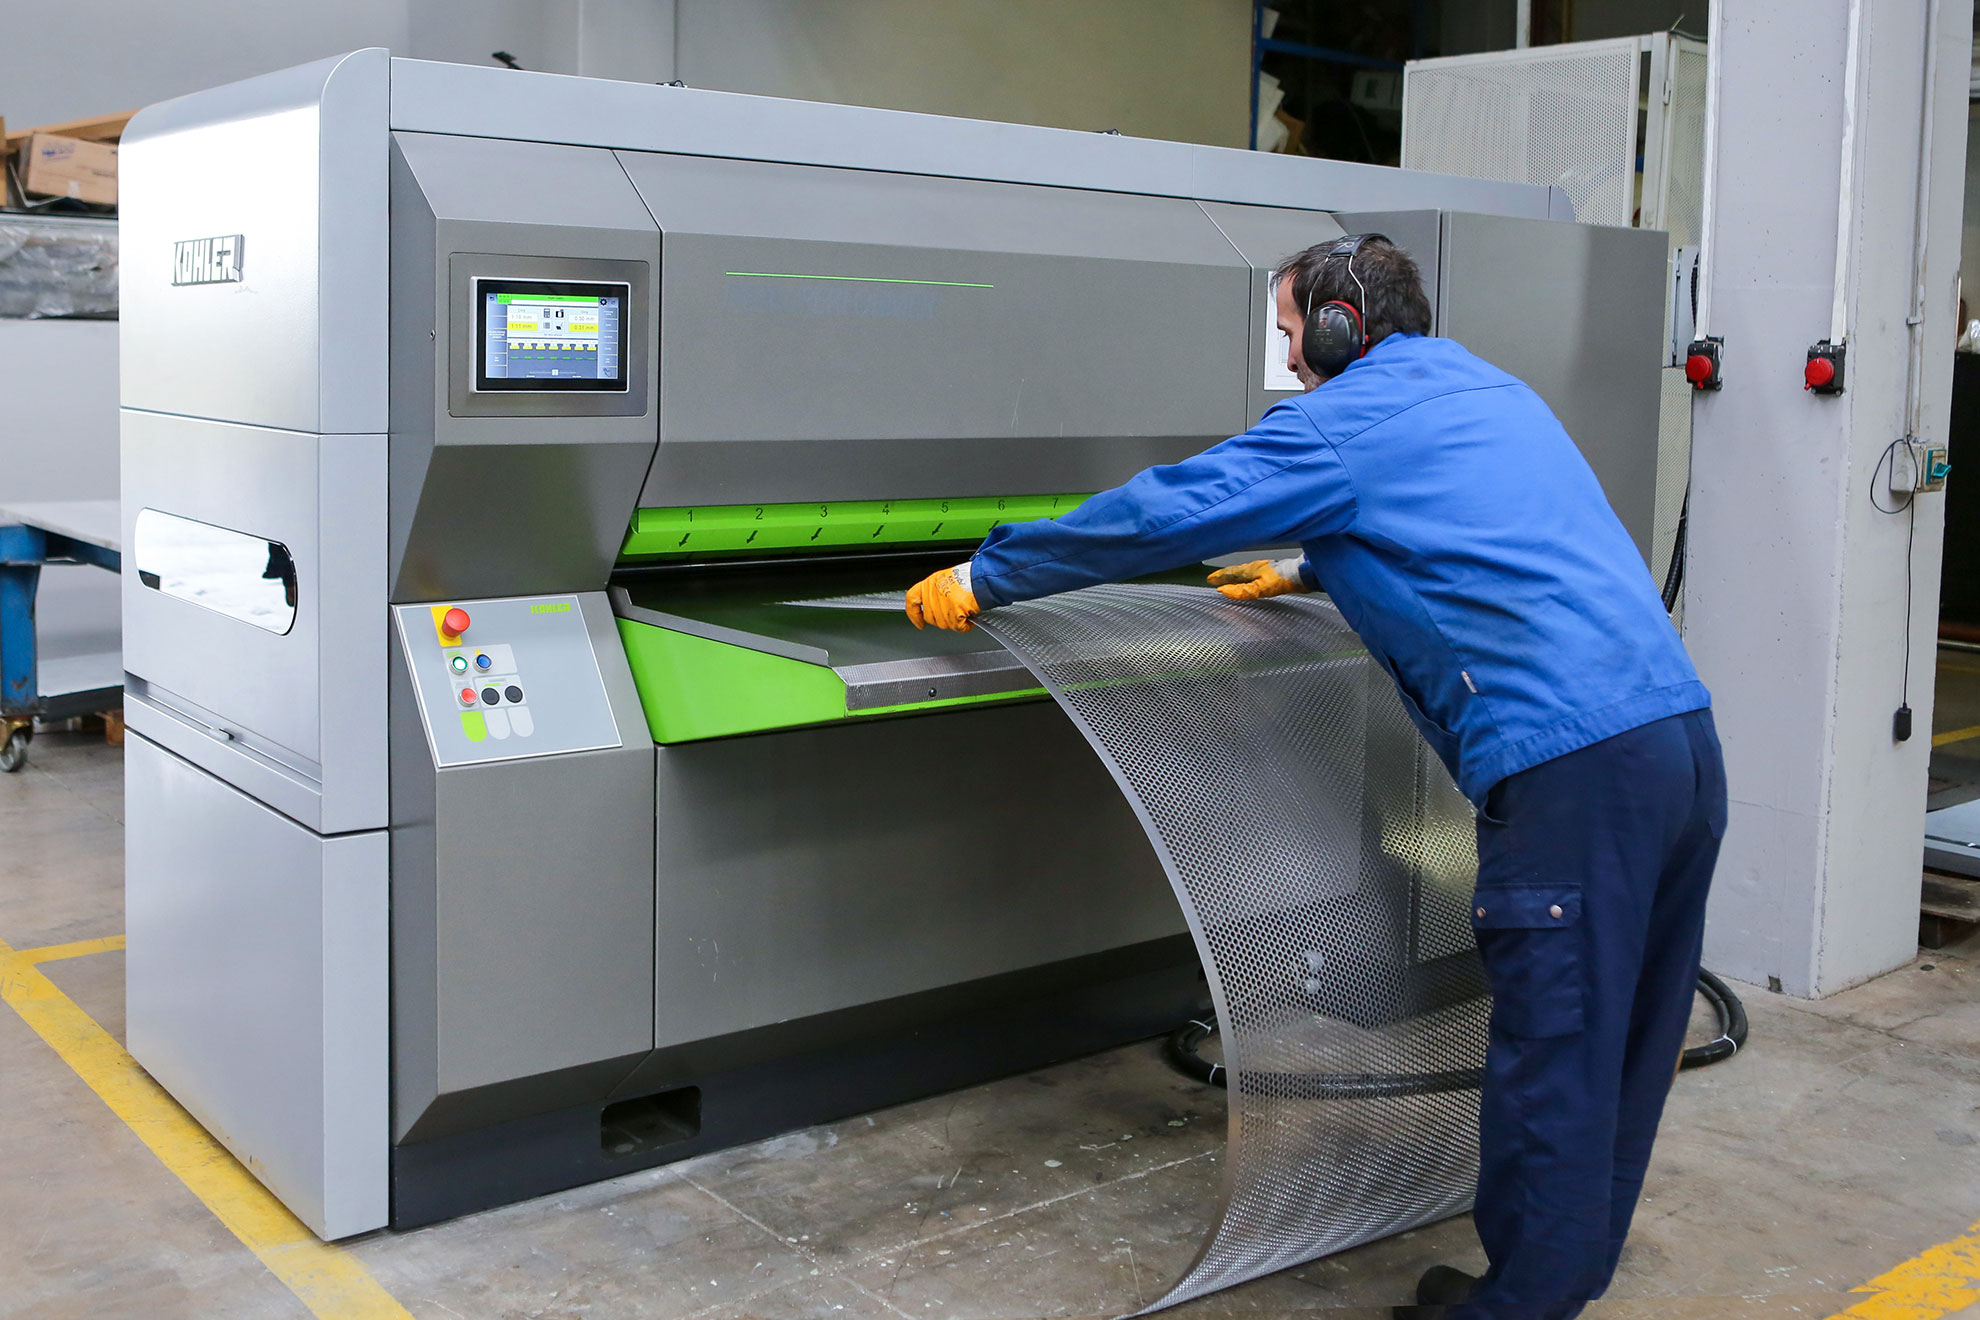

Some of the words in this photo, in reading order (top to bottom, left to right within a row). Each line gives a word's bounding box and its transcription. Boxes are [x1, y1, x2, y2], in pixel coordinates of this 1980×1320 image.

[172, 234, 245, 286] KOHLER
[687, 510, 693, 522] 1
[755, 508, 764, 520] 2
[820, 505, 828, 518] 3
[882, 503, 890, 516] 4
[941, 501, 949, 514] 5
[998, 499, 1005, 511] 6
[1052, 497, 1059, 509] 7
